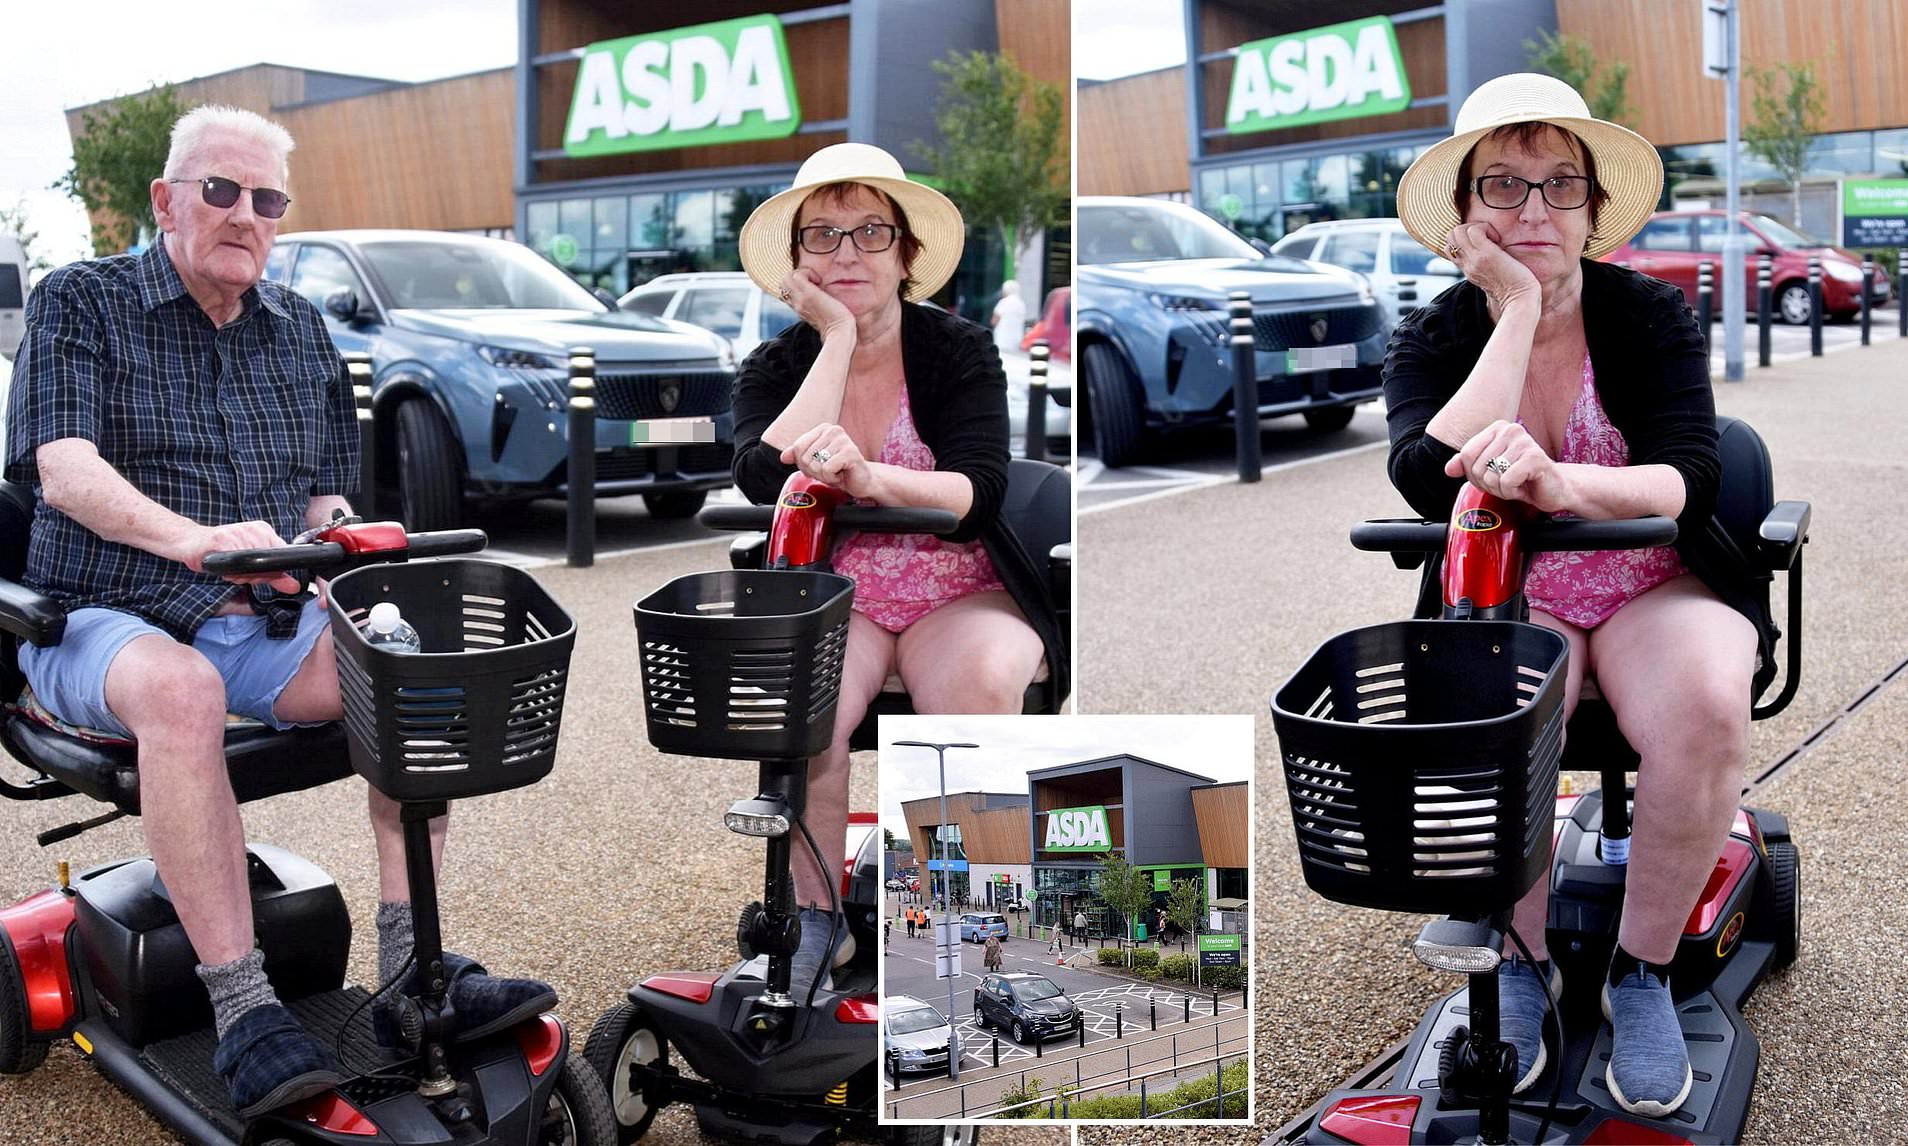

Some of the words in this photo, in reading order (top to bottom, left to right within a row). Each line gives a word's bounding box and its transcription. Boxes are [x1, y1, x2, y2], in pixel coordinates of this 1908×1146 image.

[567, 24, 792, 143] ASDA
[1227, 23, 1403, 124] ASDA
[1045, 810, 1109, 848] ASDA
